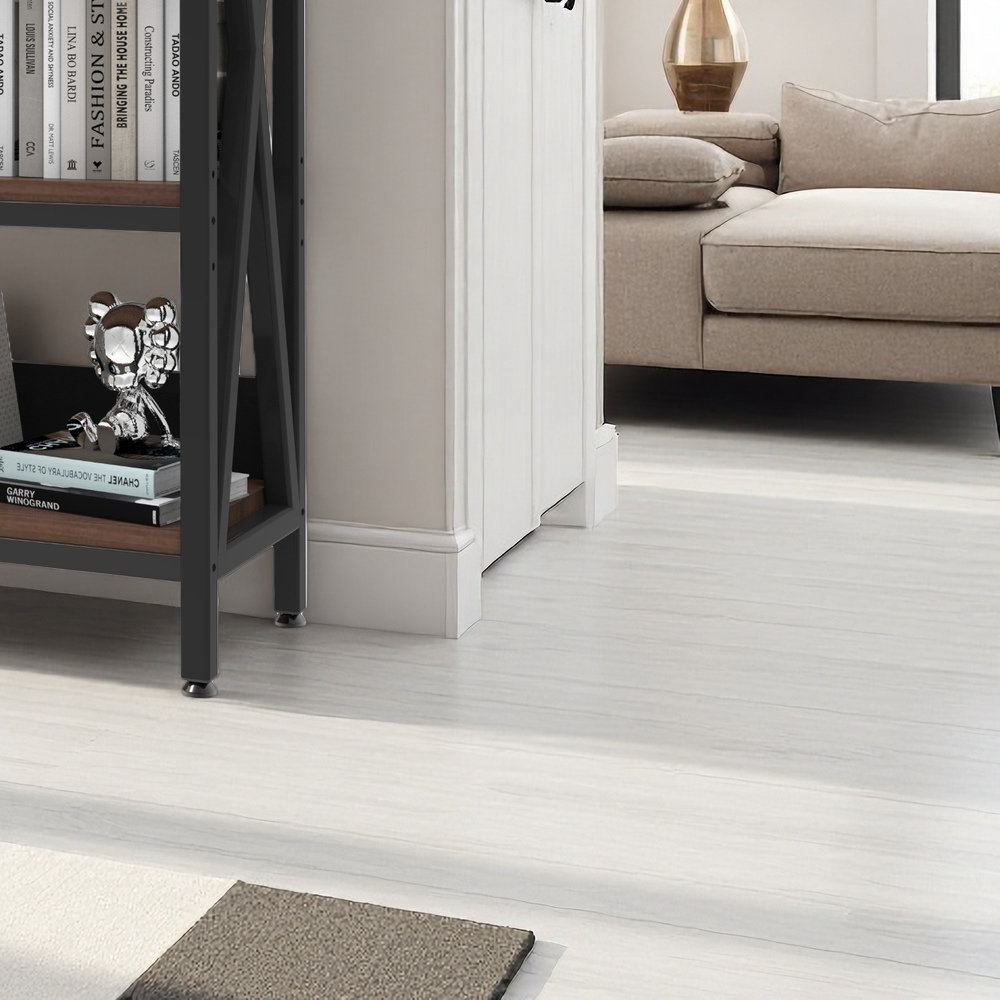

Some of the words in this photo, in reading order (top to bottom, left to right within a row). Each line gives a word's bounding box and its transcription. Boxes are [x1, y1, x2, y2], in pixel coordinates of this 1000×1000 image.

[116, 2, 128, 28] HOME
[25, 23, 36, 42] LOUIS
[67, 26, 77, 51] LINA
[91, 30, 105, 46] &
[116, 30, 128, 60] HOUSE
[25, 43, 36, 75] SULLIVAN
[67, 53, 77, 68] BO
[142, 25, 155, 77] Constructing
[171, 33, 180, 67] TADAO
[116, 63, 128, 81] THE
[171, 69, 180, 97] ANDO
[67, 70, 77, 103] BARDI
[144, 78, 156, 112] Paradies
[91, 54, 104, 148] FASHION
[116, 84, 128, 128] BRINGING
[25, 141, 36, 157] CCA
[6, 486, 36, 499] GARRY
[6, 495, 60, 511] WINOGRAND
